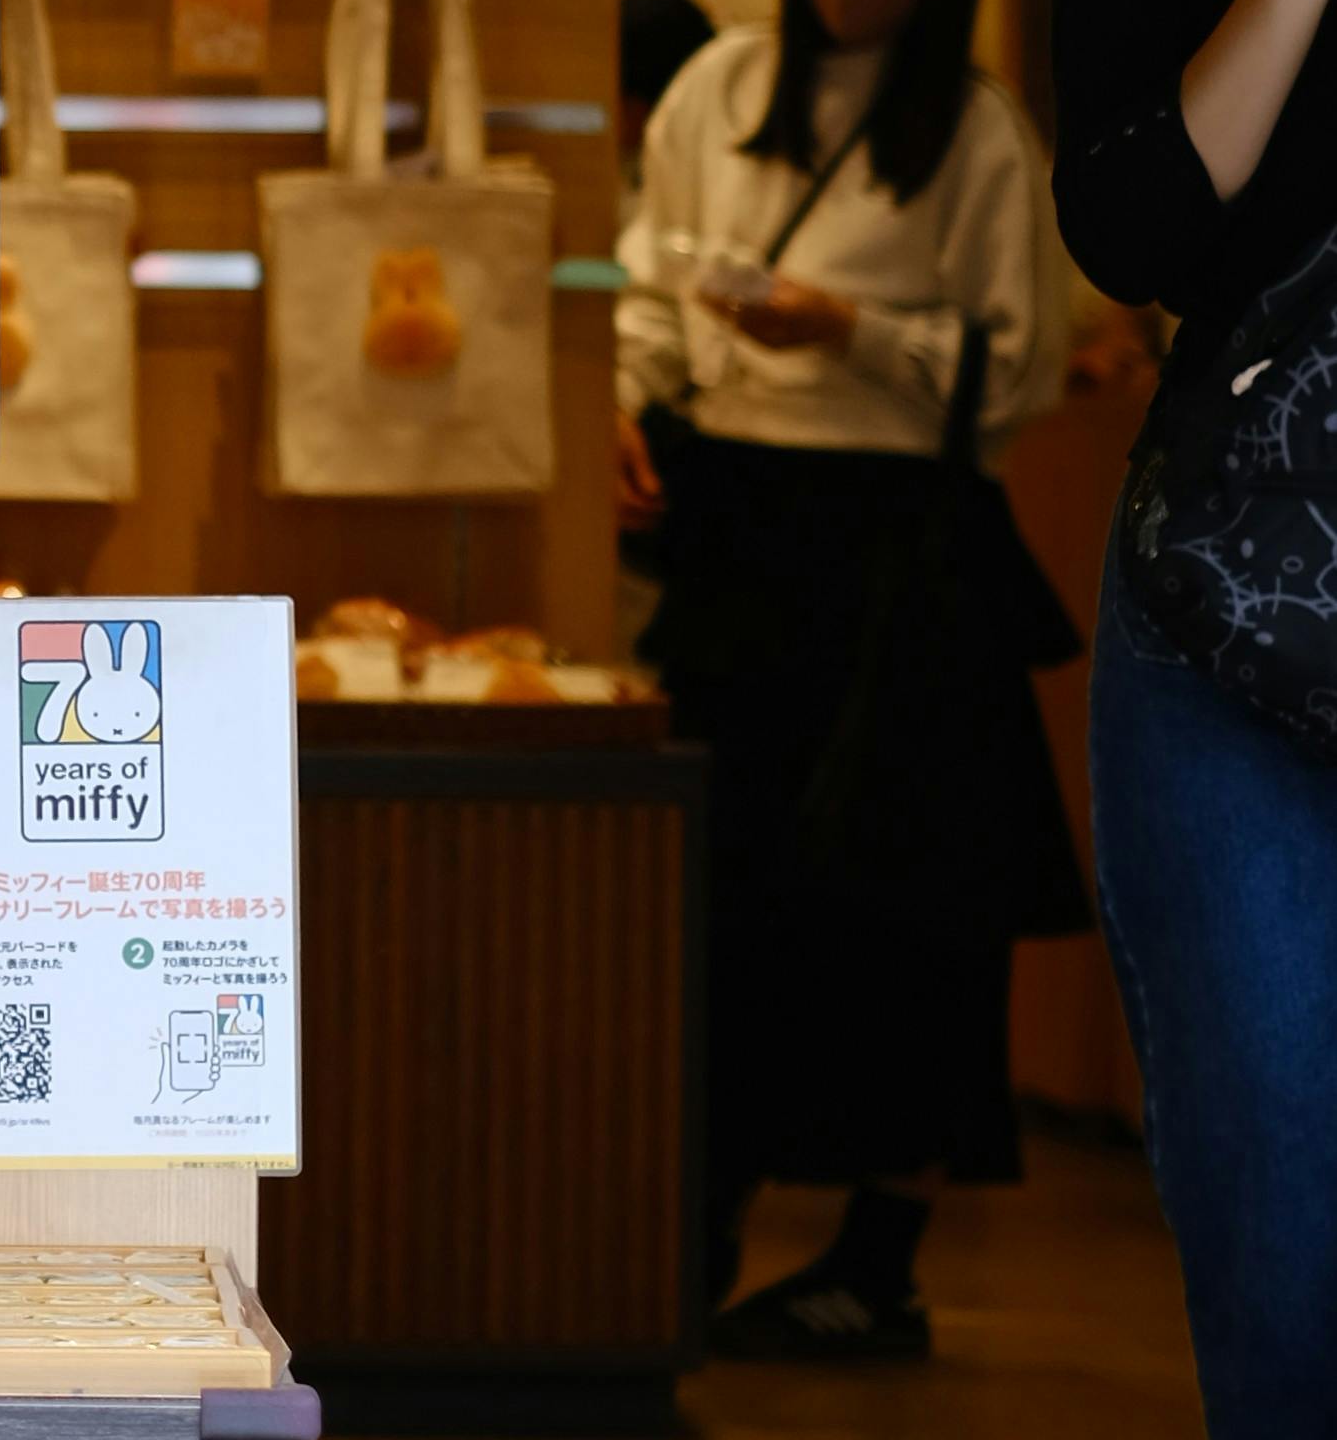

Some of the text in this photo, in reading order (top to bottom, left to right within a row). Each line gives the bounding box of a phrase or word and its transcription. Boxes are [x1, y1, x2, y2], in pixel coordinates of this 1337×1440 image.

[35, 755, 149, 786] years of
[35, 785, 149, 830] miffy
[222, 1047, 260, 1062] miffy
